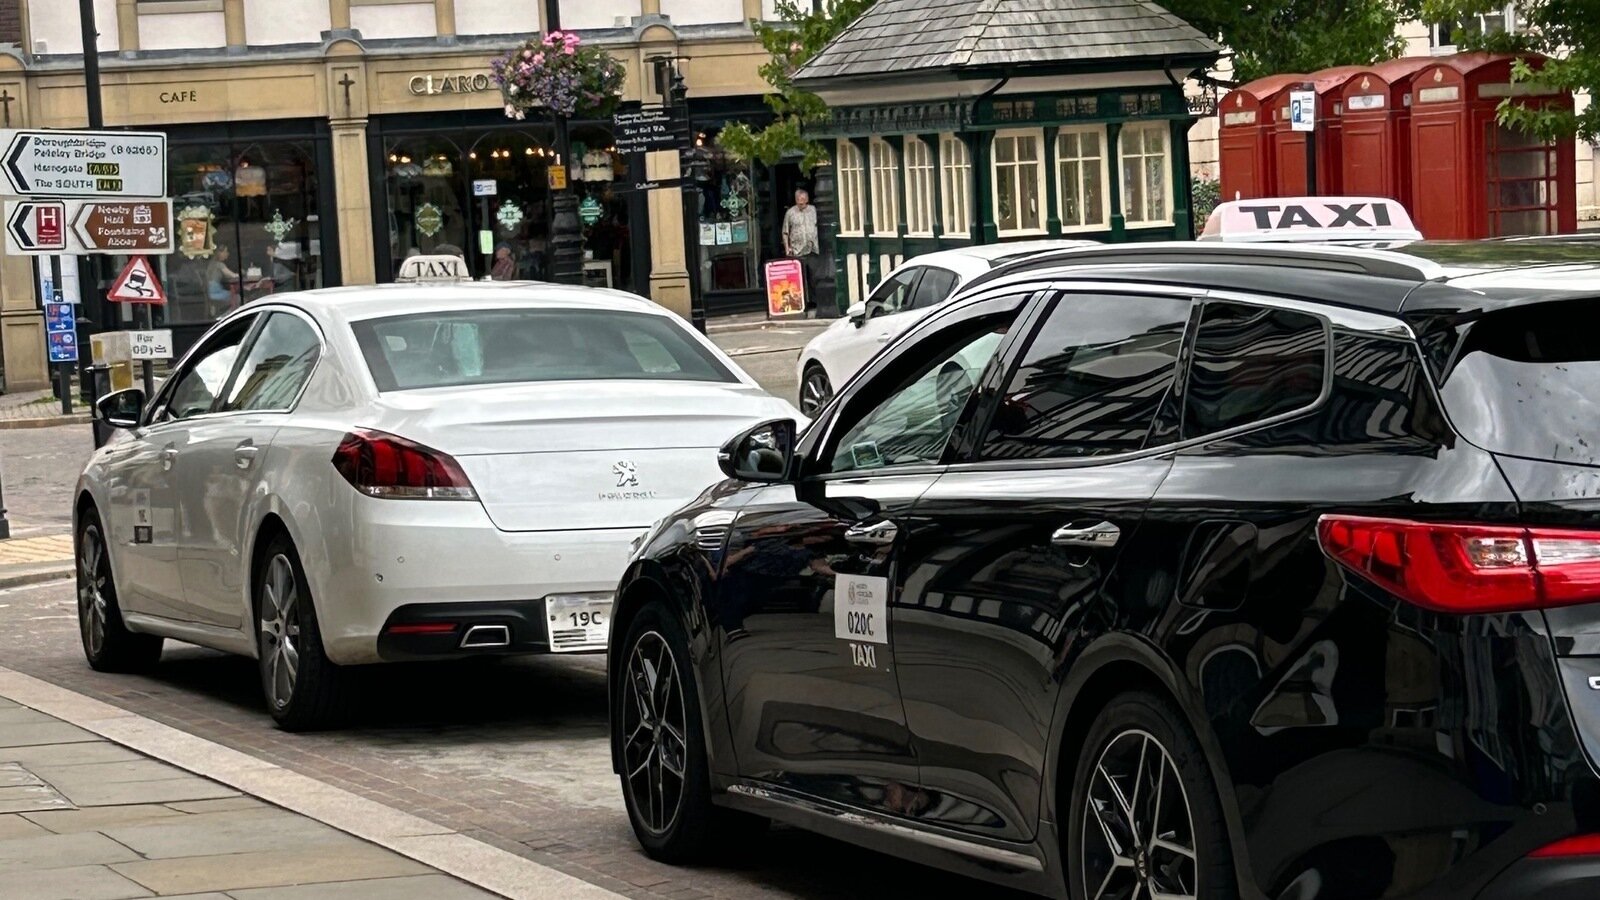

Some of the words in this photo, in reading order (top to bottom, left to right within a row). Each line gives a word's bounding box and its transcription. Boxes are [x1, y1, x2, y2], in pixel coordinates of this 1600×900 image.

[408, 72, 490, 95] CLARO
[56, 179, 93, 188] SOUTH
[41, 208, 57, 227] H
[1239, 203, 1391, 229] TAXI
[412, 261, 458, 277] TAXI
[569, 611, 603, 627] 19C
[847, 611, 874, 636] 020C
[850, 643, 876, 668] TAXI
